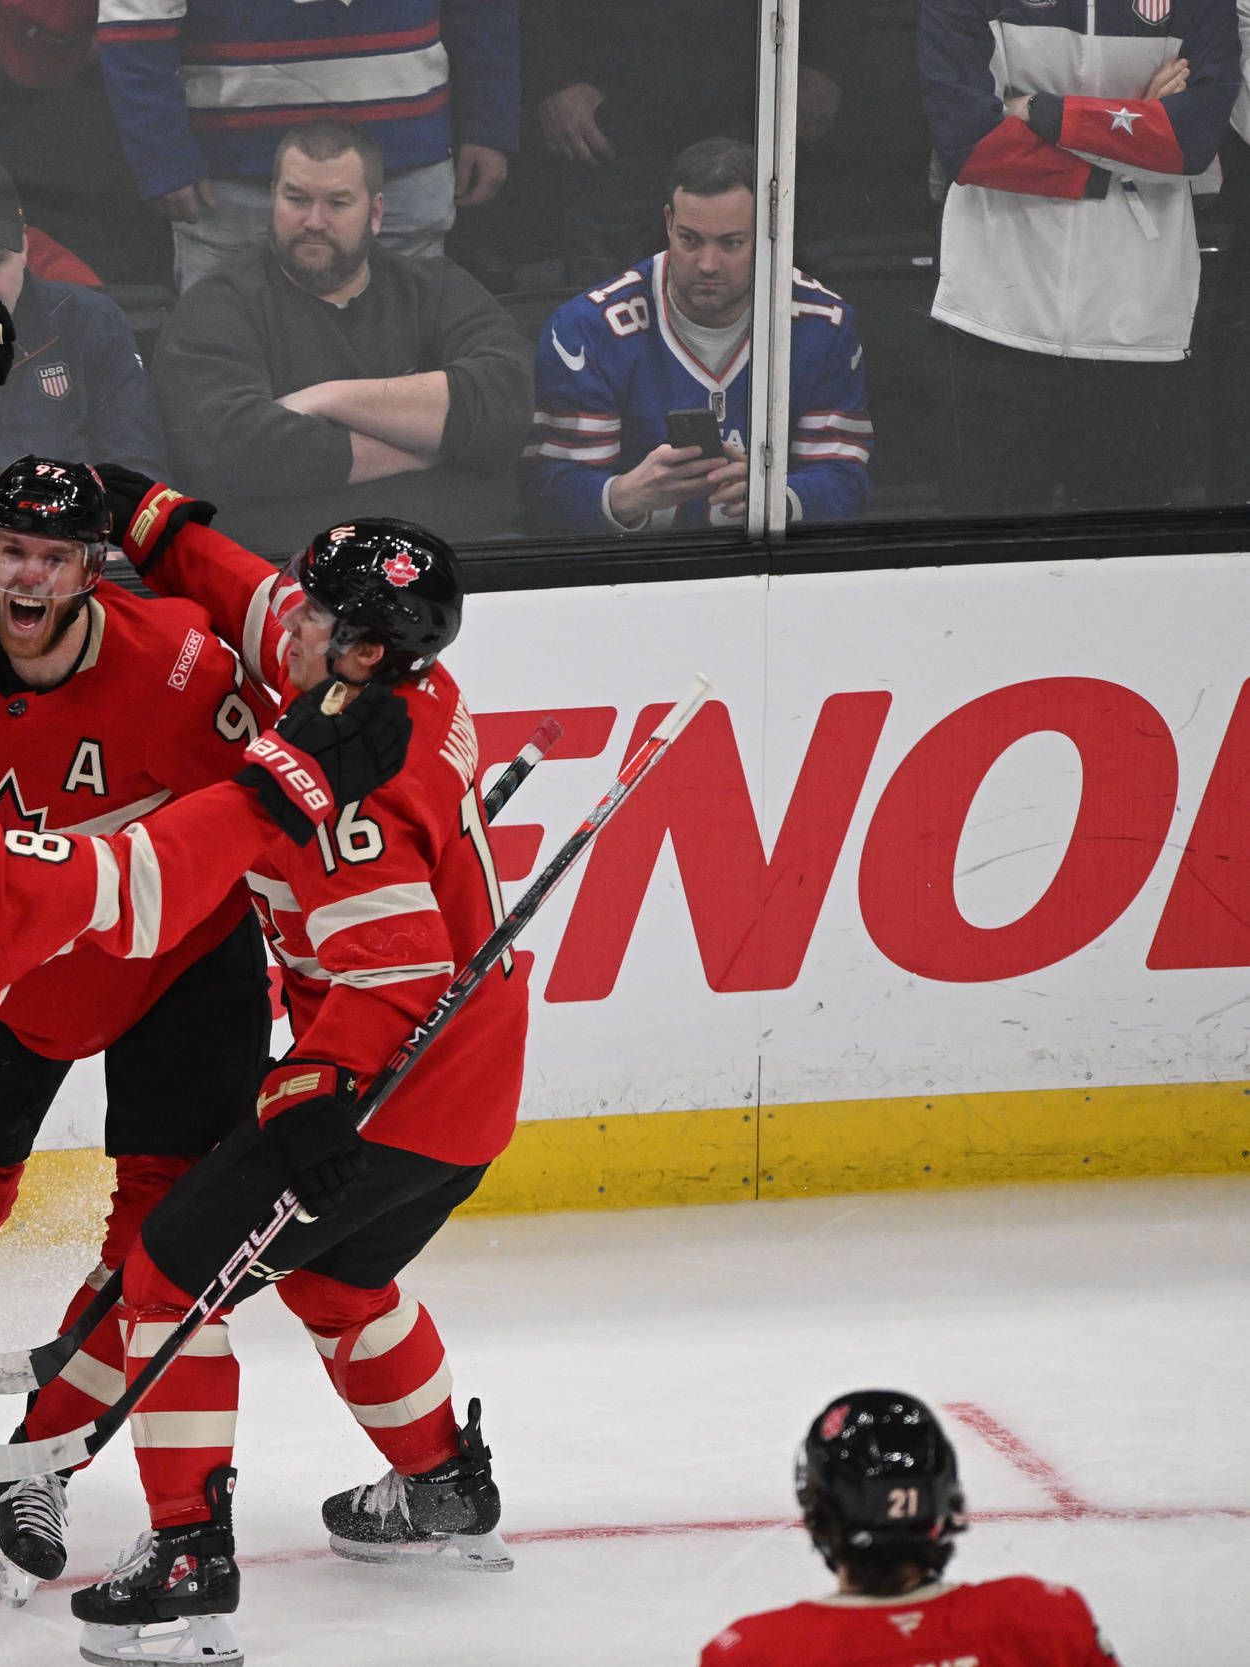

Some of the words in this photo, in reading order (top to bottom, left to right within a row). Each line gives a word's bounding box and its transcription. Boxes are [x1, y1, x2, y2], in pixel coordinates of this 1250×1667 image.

[40, 366, 65, 378] USA
[35, 464, 66, 480] 97
[177, 632, 202, 673] ROGERS
[65, 737, 109, 797] A
[4, 829, 76, 864] 8
[316, 799, 386, 877] 16
[888, 1488, 919, 1518] 21
